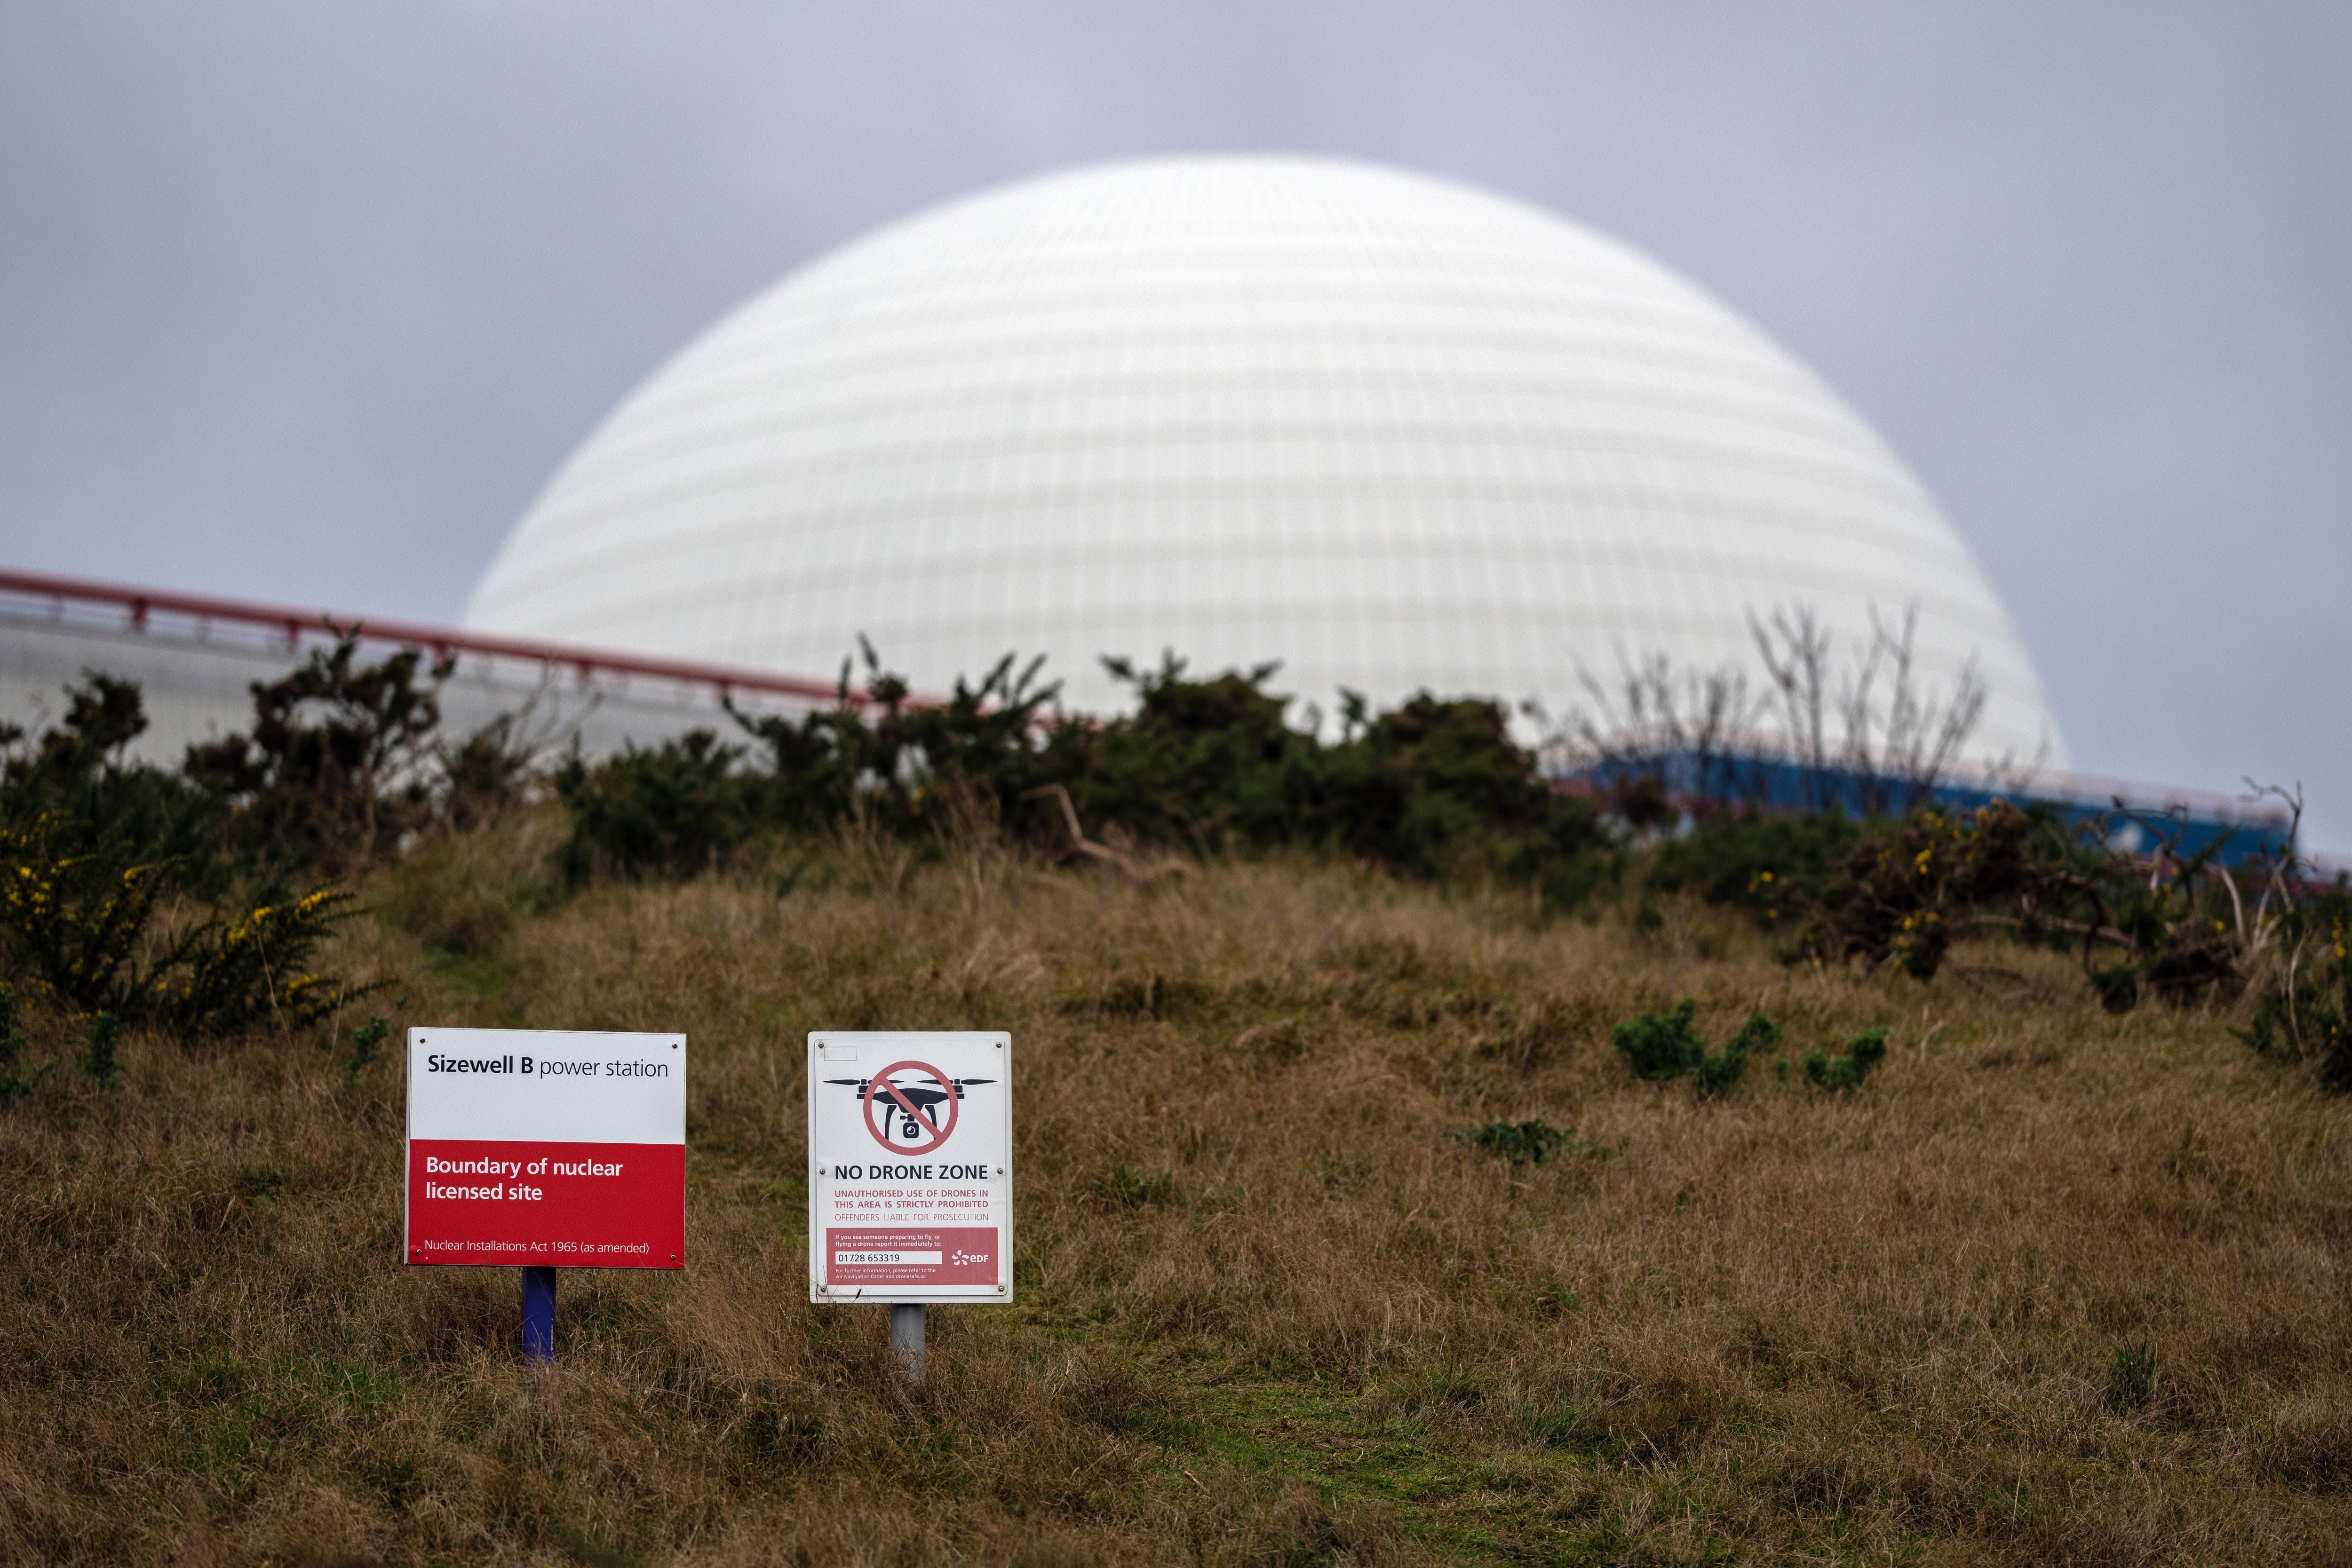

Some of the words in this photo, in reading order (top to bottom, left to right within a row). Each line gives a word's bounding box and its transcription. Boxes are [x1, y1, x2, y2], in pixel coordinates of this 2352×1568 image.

[429, 1054, 513, 1073] Sizewell
[521, 1057, 533, 1074] B
[540, 1061, 600, 1078] power
[606, 1059, 667, 1077] station
[427, 1157, 521, 1178] Boundary
[527, 1158, 548, 1174] of
[554, 1159, 623, 1176] nuclear
[835, 1165, 862, 1180] NO
[870, 1165, 932, 1179] DRONE
[939, 1165, 987, 1179] ZONE
[427, 1182, 502, 1199] licensed
[509, 1184, 542, 1200] site
[425, 1240, 463, 1250] Nuclear
[468, 1241, 526, 1251] Installations
[530, 1242, 547, 1251] Act
[552, 1242, 577, 1251] 1965
[581, 1243, 594, 1253] (as
[598, 1243, 649, 1254] amended)
